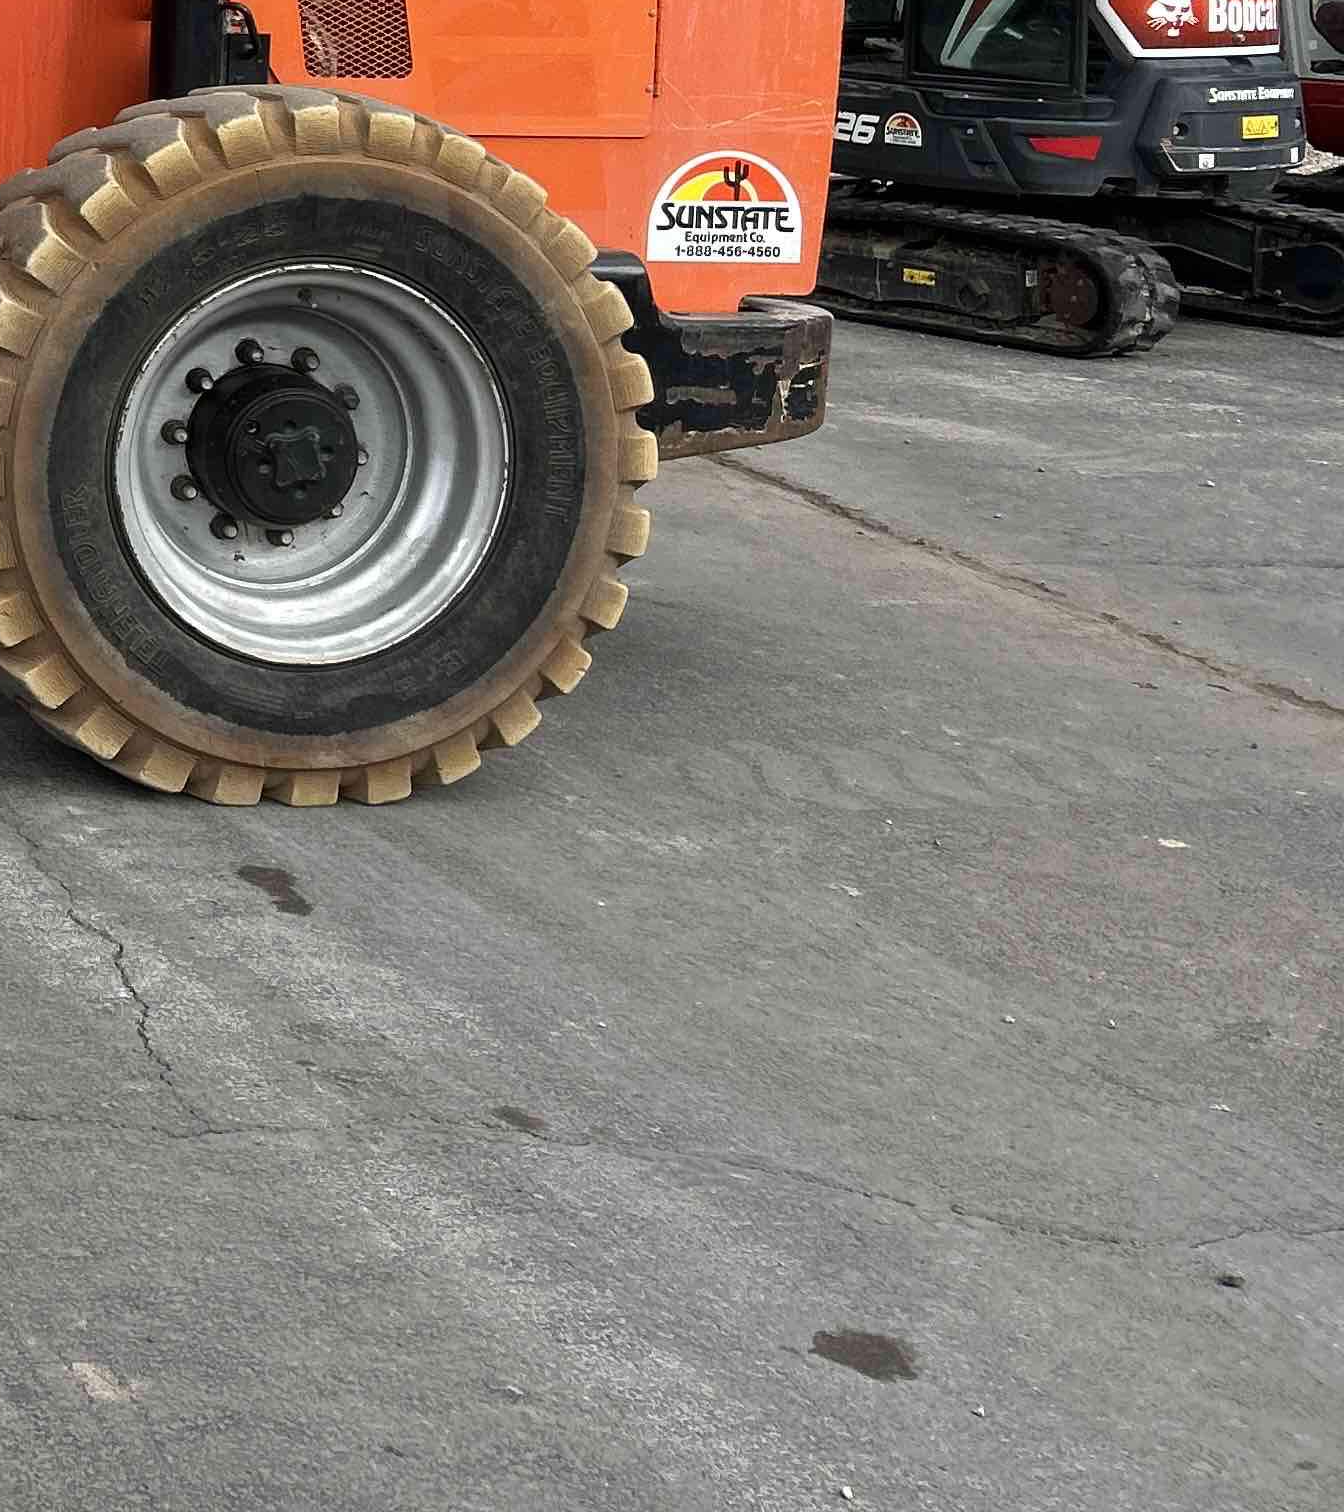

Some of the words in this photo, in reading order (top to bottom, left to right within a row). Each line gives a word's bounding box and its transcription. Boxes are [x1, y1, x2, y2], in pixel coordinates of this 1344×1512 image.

[656, 202, 794, 232] SUNSTATE
[685, 231, 747, 244] Equipment
[750, 232, 765, 243] Co.
[674, 245, 781, 258] 1-888-456-4560
